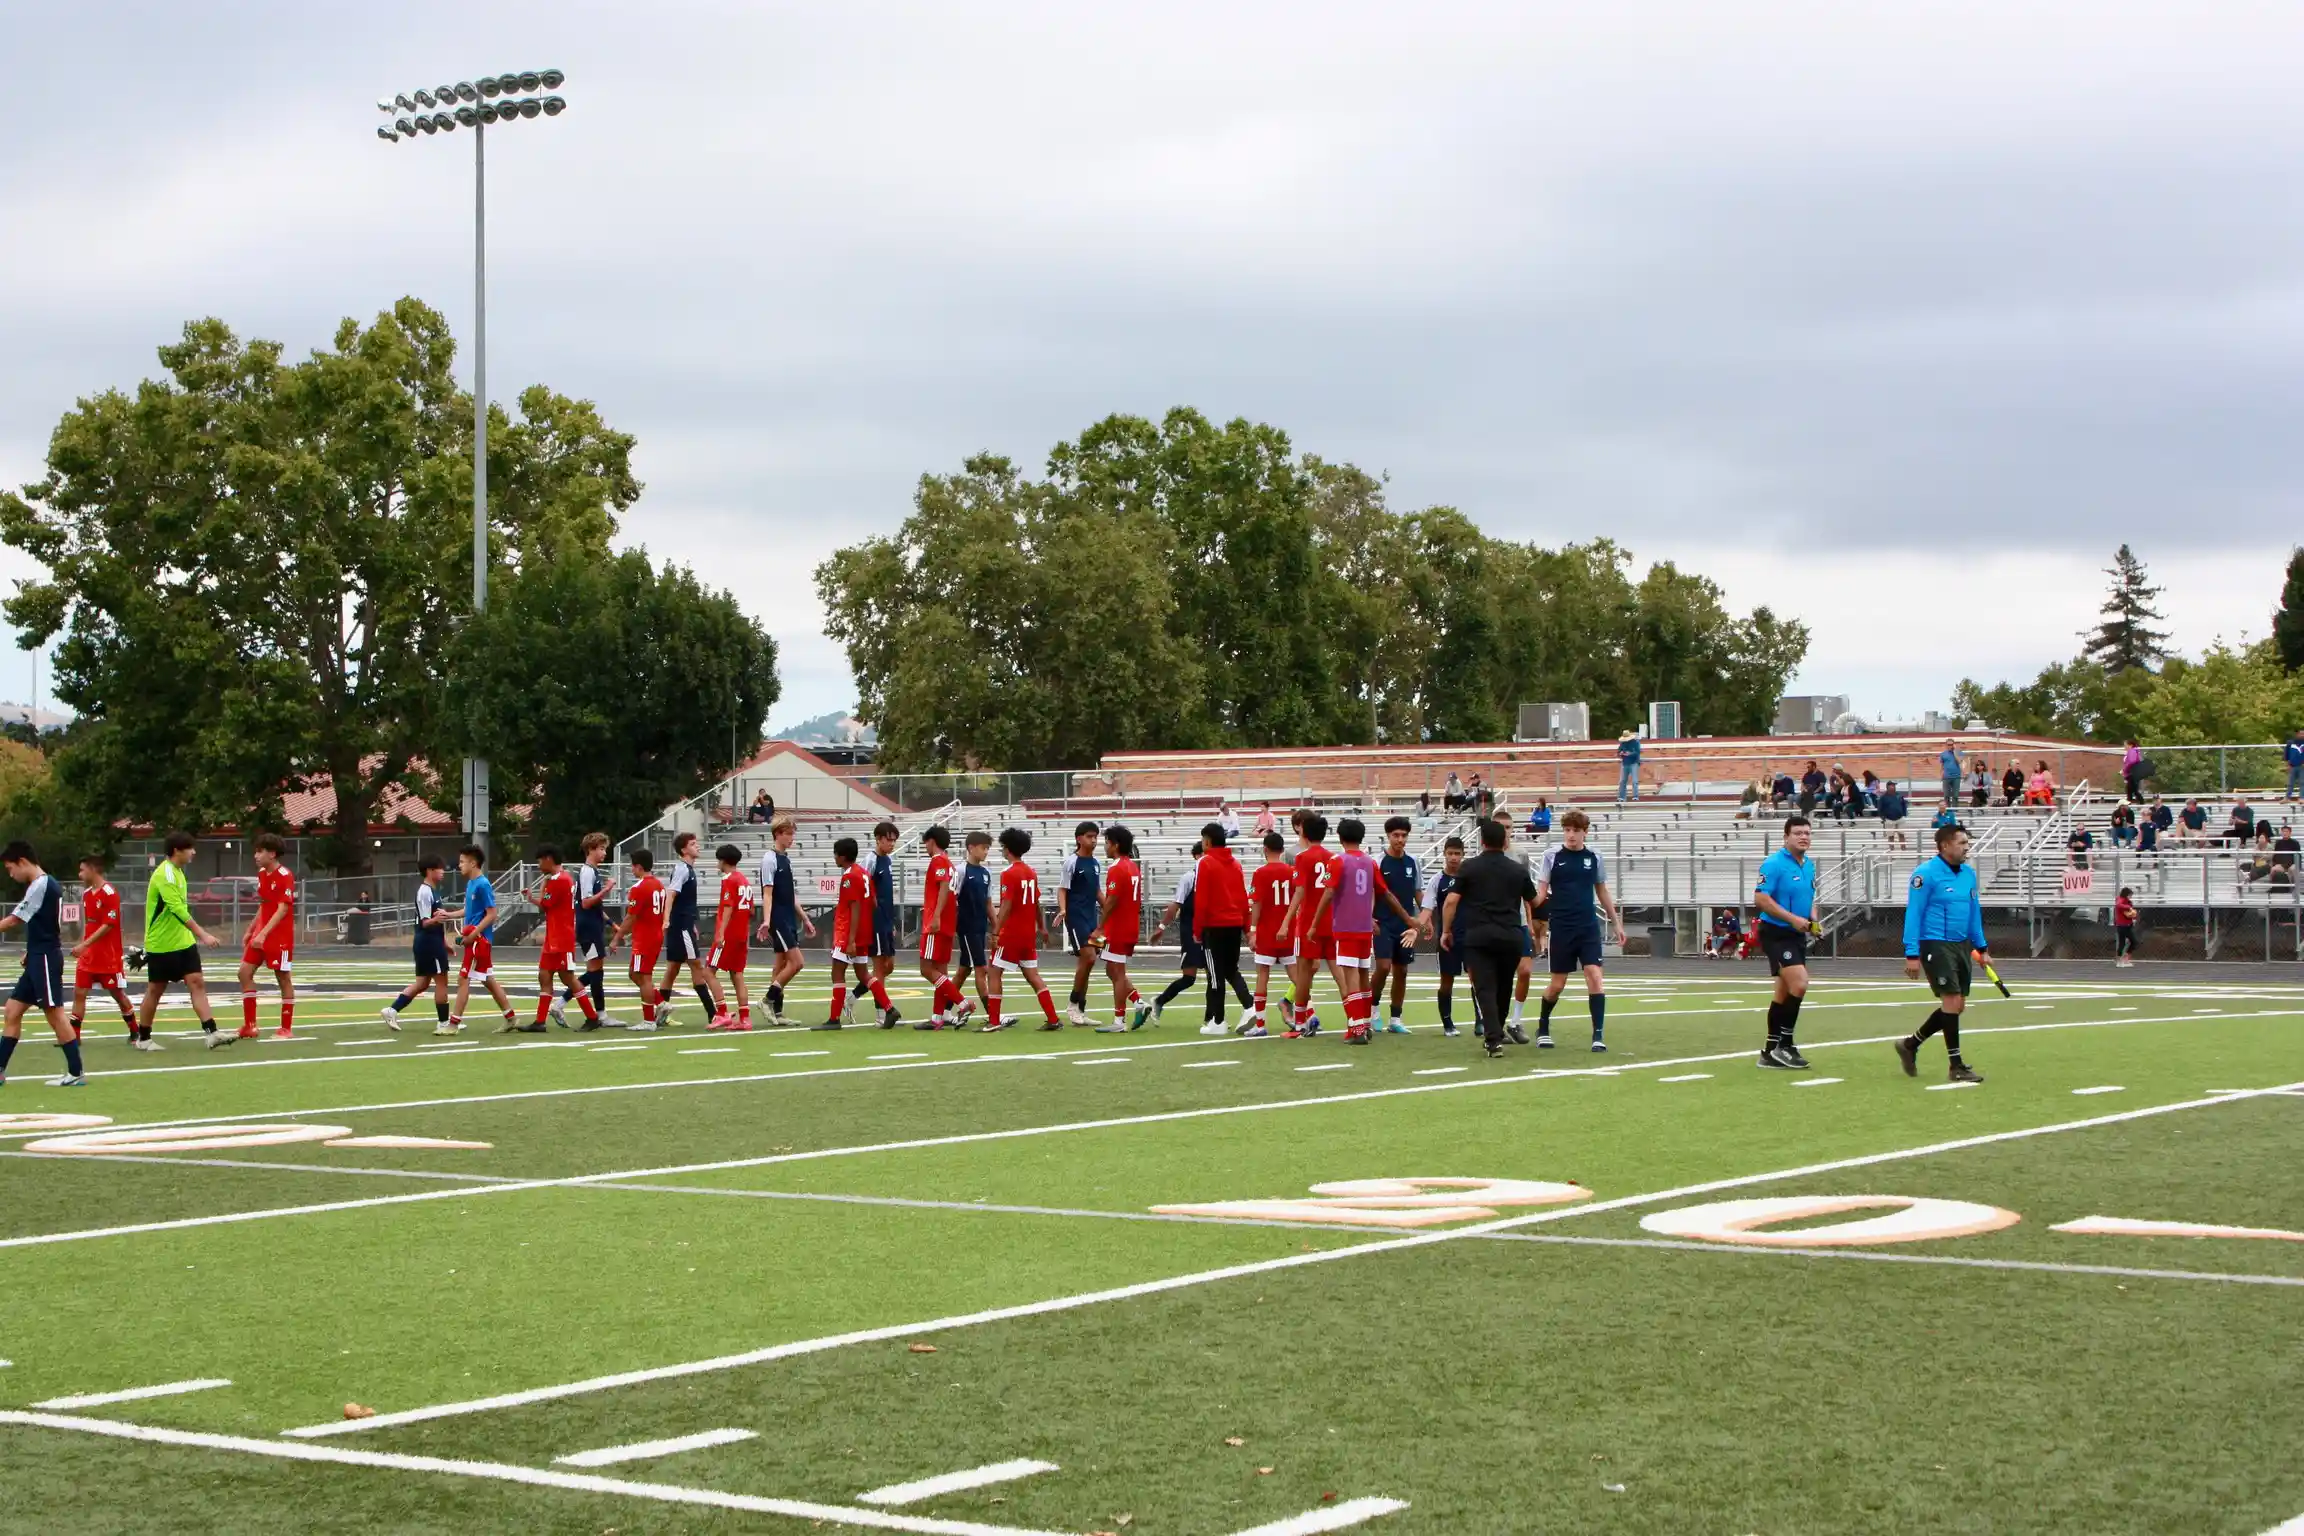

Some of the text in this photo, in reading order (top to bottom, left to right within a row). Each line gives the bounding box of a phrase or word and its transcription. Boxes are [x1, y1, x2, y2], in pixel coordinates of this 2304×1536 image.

[1021, 880, 1035, 905] 71
[1131, 876, 1139, 901] 7
[1272, 879, 1290, 905] 11
[1355, 869, 1367, 895] 9
[2064, 876, 2090, 890] UVW
